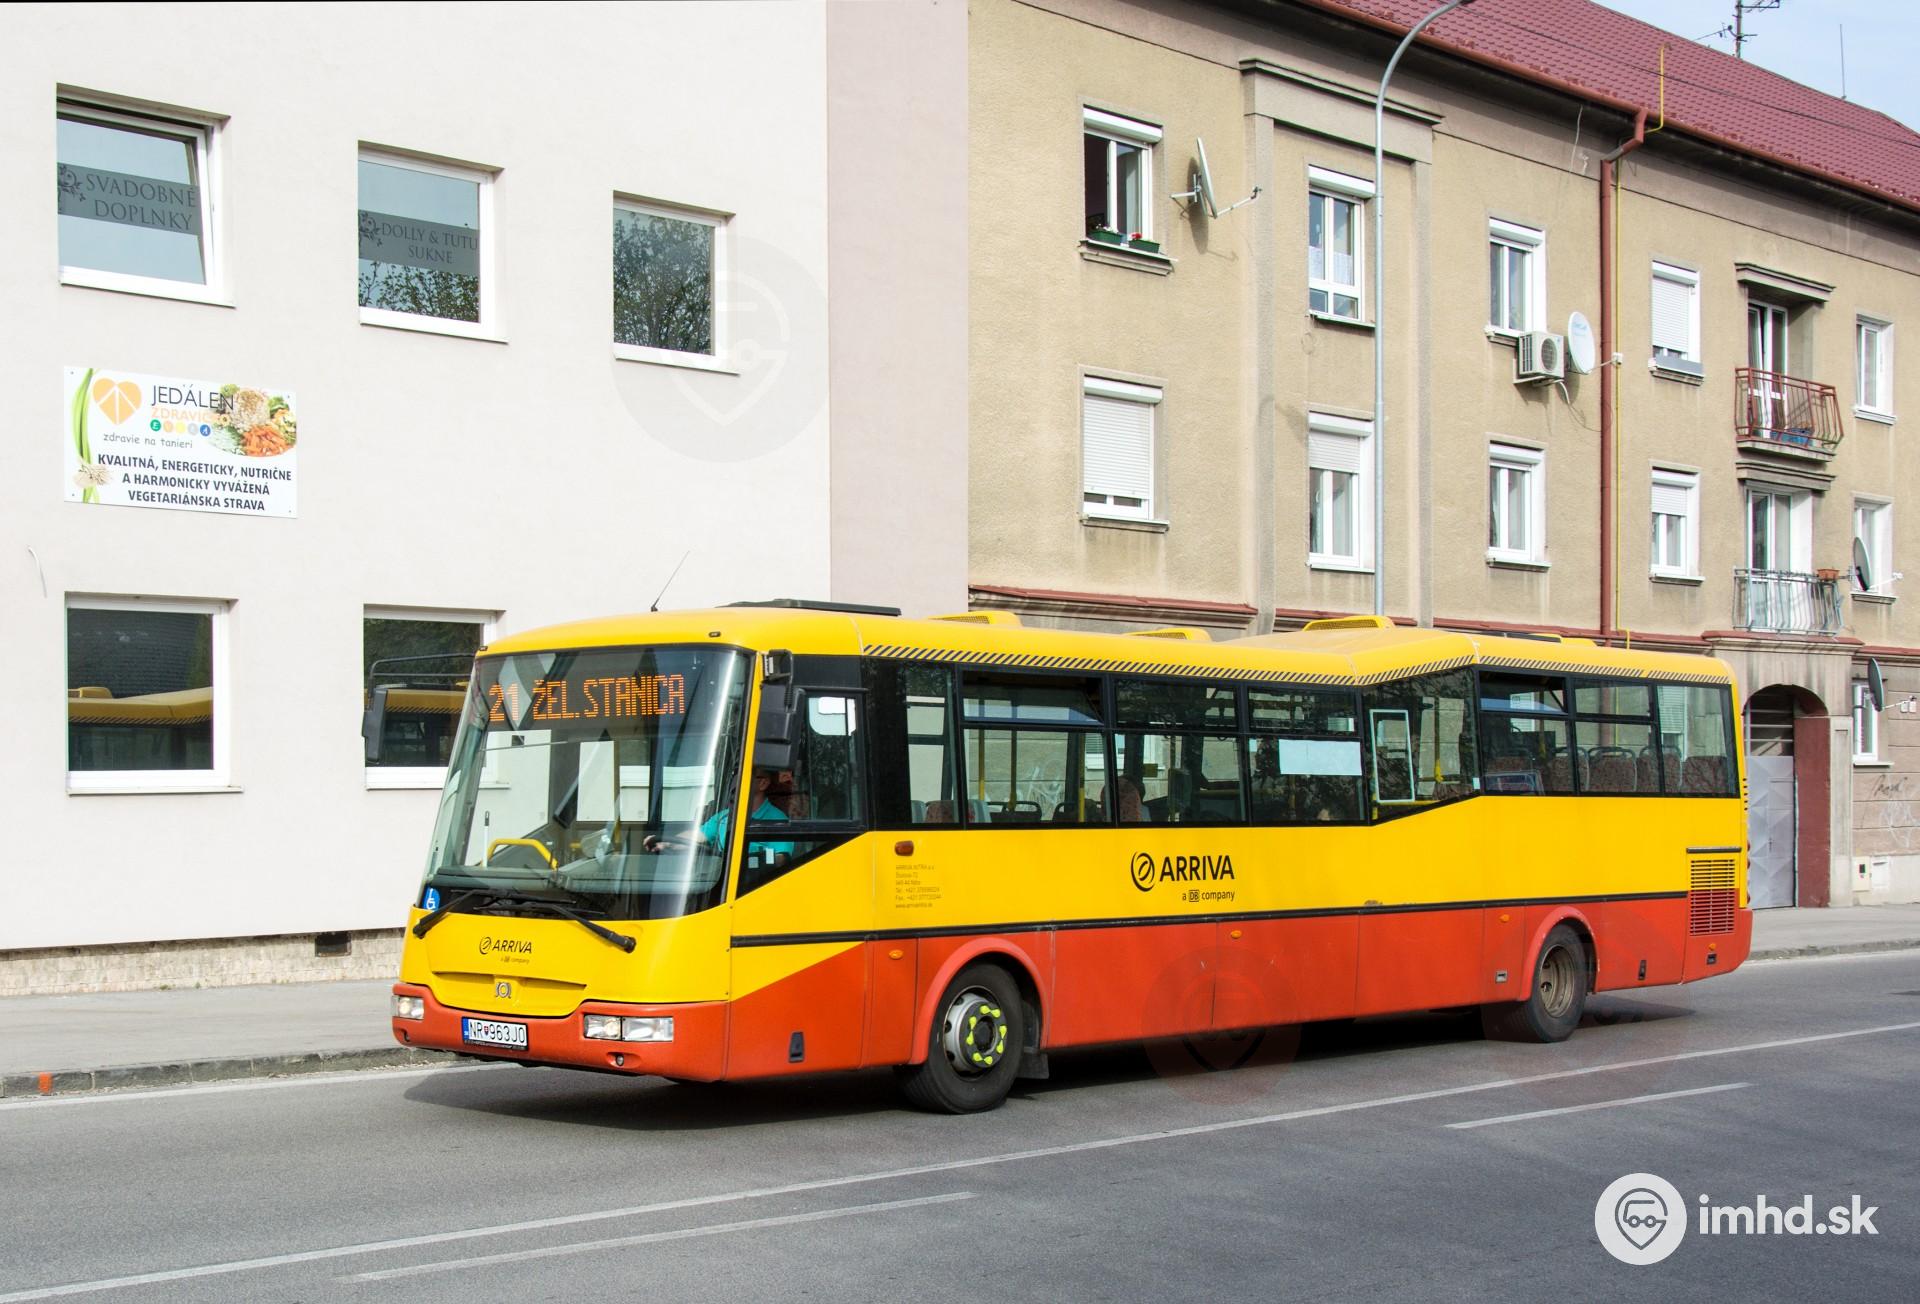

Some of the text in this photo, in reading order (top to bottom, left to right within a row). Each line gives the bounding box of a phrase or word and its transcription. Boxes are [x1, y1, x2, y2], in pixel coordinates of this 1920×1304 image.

[86, 174, 197, 208] SVADOBNÉ
[94, 199, 193, 231] DOPLNKY
[382, 222, 478, 251] DOLLY & TUTU
[408, 244, 454, 264] SUKNE
[103, 432, 193, 449] zdravie na tanieri
[98, 454, 292, 481] KVALITNÁ, ENERGETICKY, NUTRIČNE
[122, 473, 270, 496] A HARMONICKY VYVÁŽENÁ
[128, 490, 265, 511] VEGETARIÁNSKA STRAVA
[488, 682, 519, 722] 21
[1160, 854, 1235, 882] ARRIVA
[1182, 889, 1235, 902] a DB company
[492, 939, 533, 954] ARRIVA
